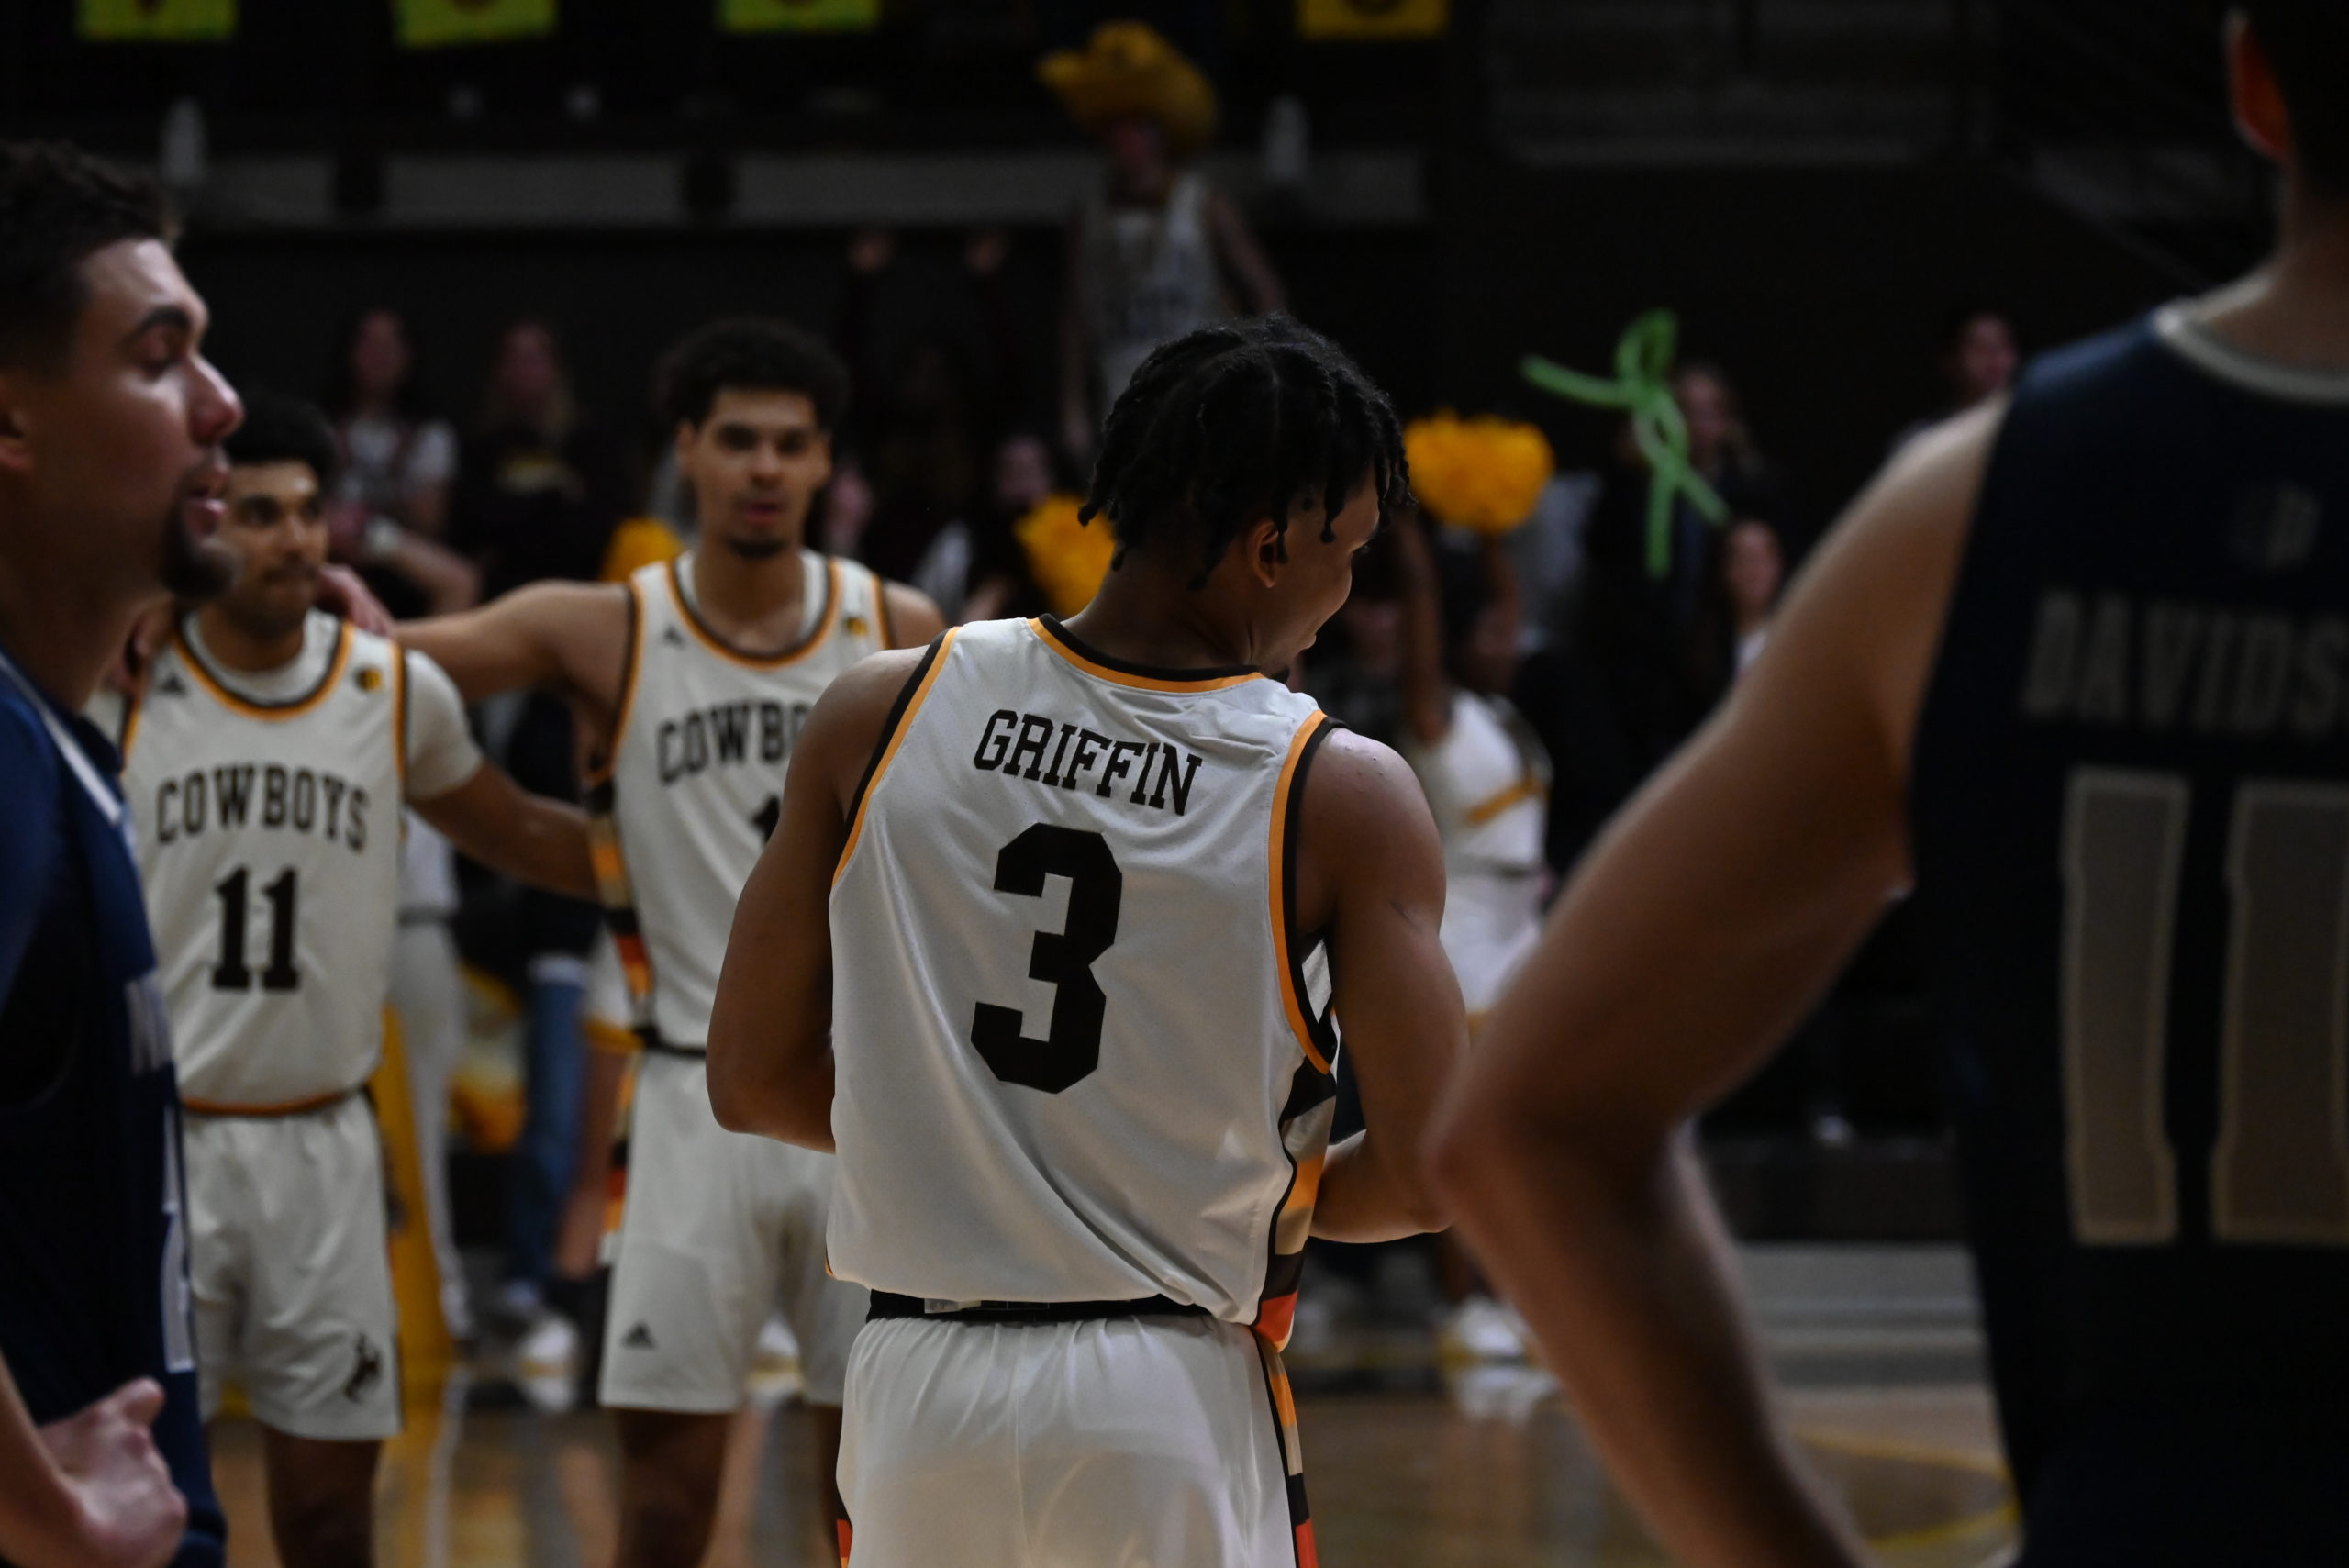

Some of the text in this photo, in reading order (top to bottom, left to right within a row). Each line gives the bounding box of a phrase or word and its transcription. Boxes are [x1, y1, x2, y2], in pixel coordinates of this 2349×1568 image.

[156, 763, 369, 854] COWBOYS
[974, 709, 1203, 816] GRIFFIN
[213, 866, 299, 991] 11
[971, 822, 1122, 1094] 3
